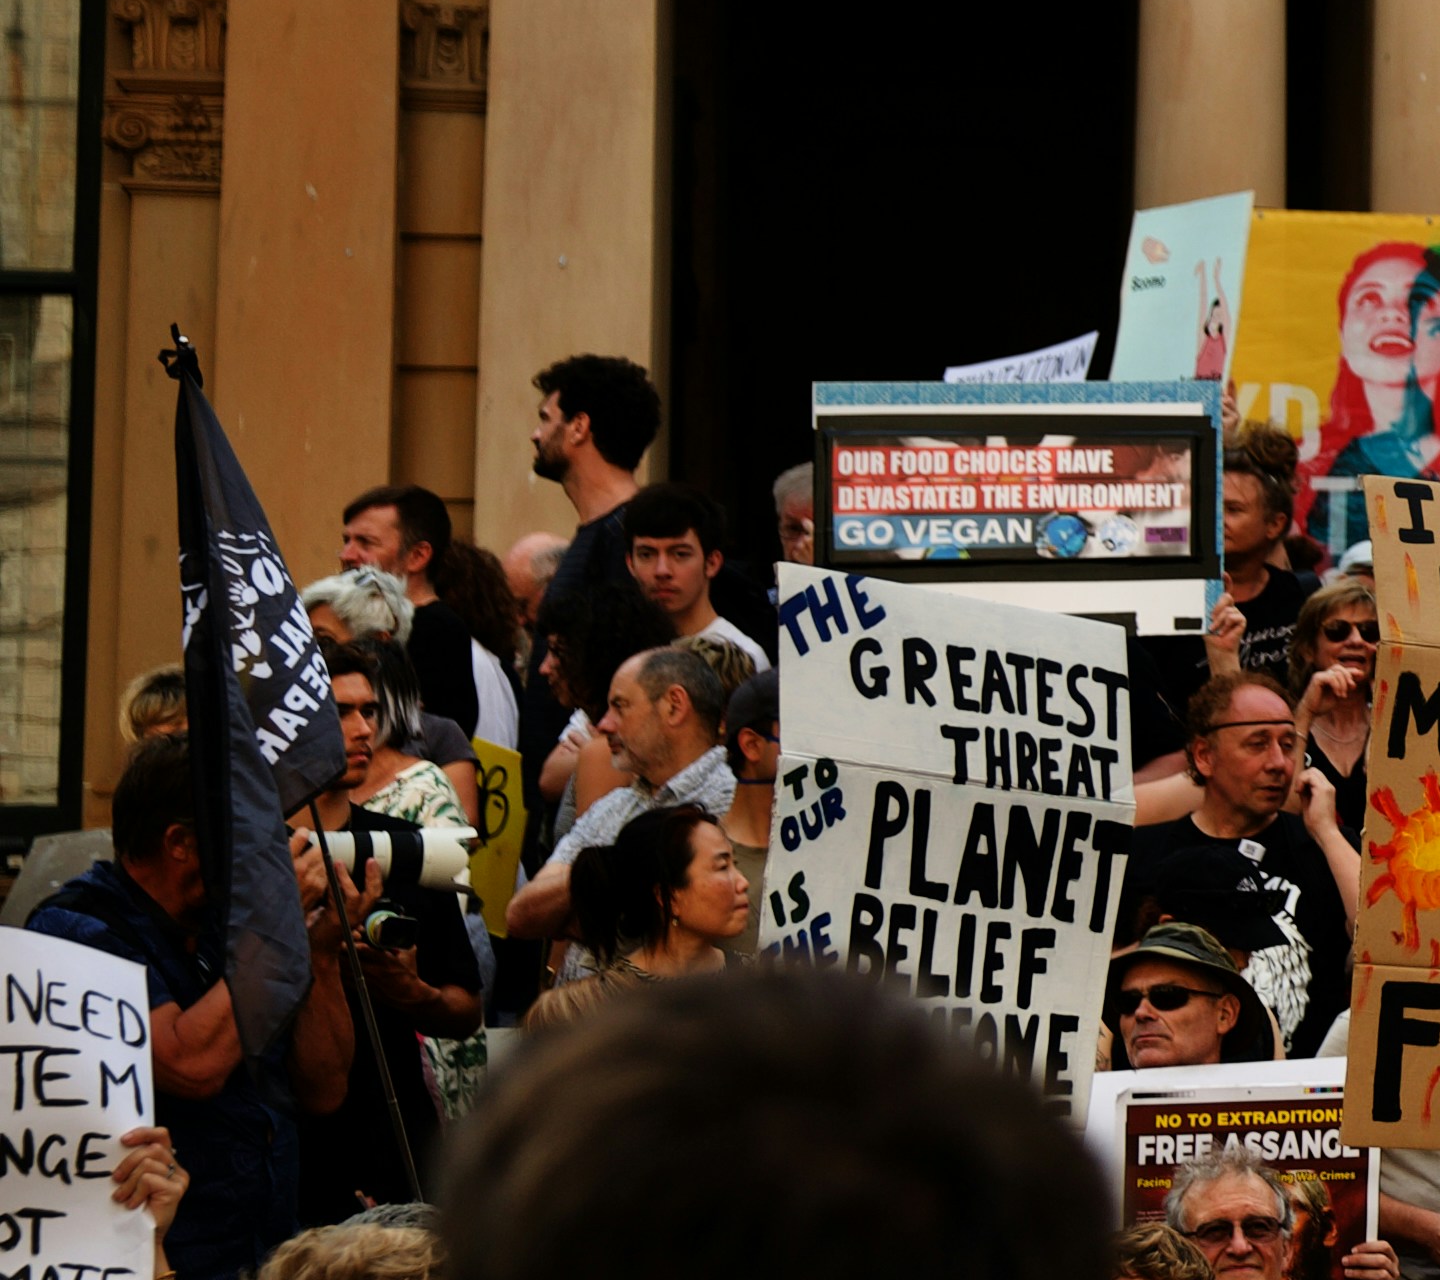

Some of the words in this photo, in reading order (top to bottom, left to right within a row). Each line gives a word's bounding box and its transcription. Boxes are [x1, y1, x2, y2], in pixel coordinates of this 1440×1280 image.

[838, 449, 886, 476] OUR
[890, 449, 950, 475] FOOD
[953, 449, 1052, 475] CHOICES
[1056, 449, 1114, 475] HAVE
[838, 483, 977, 510] DEVASTATED
[981, 483, 1023, 509] THE
[1027, 482, 1185, 509] ENVIRONMENT
[1393, 481, 1435, 545] I
[838, 519, 894, 546] GO
[900, 518, 1033, 546] VEGAN
[779, 575, 886, 656] THE
[849, 637, 1130, 741] GREATEST
[783, 758, 839, 802] TO
[939, 724, 1119, 800] THREAT
[780, 786, 847, 852] OUR
[864, 780, 1134, 933] PLANET
[769, 871, 811, 928] IS
[846, 892, 1057, 1010] BELIEF
[7, 969, 147, 1049] NEED
[1155, 1114, 1182, 1128] NO
[1188, 1113, 1212, 1127] TO
[1217, 1108, 1345, 1126] EXTRADITION!
[1137, 1177, 1171, 1189] Facing
[1319, 1170, 1355, 1182] Crimes
[1138, 1133, 1213, 1166] FREE
